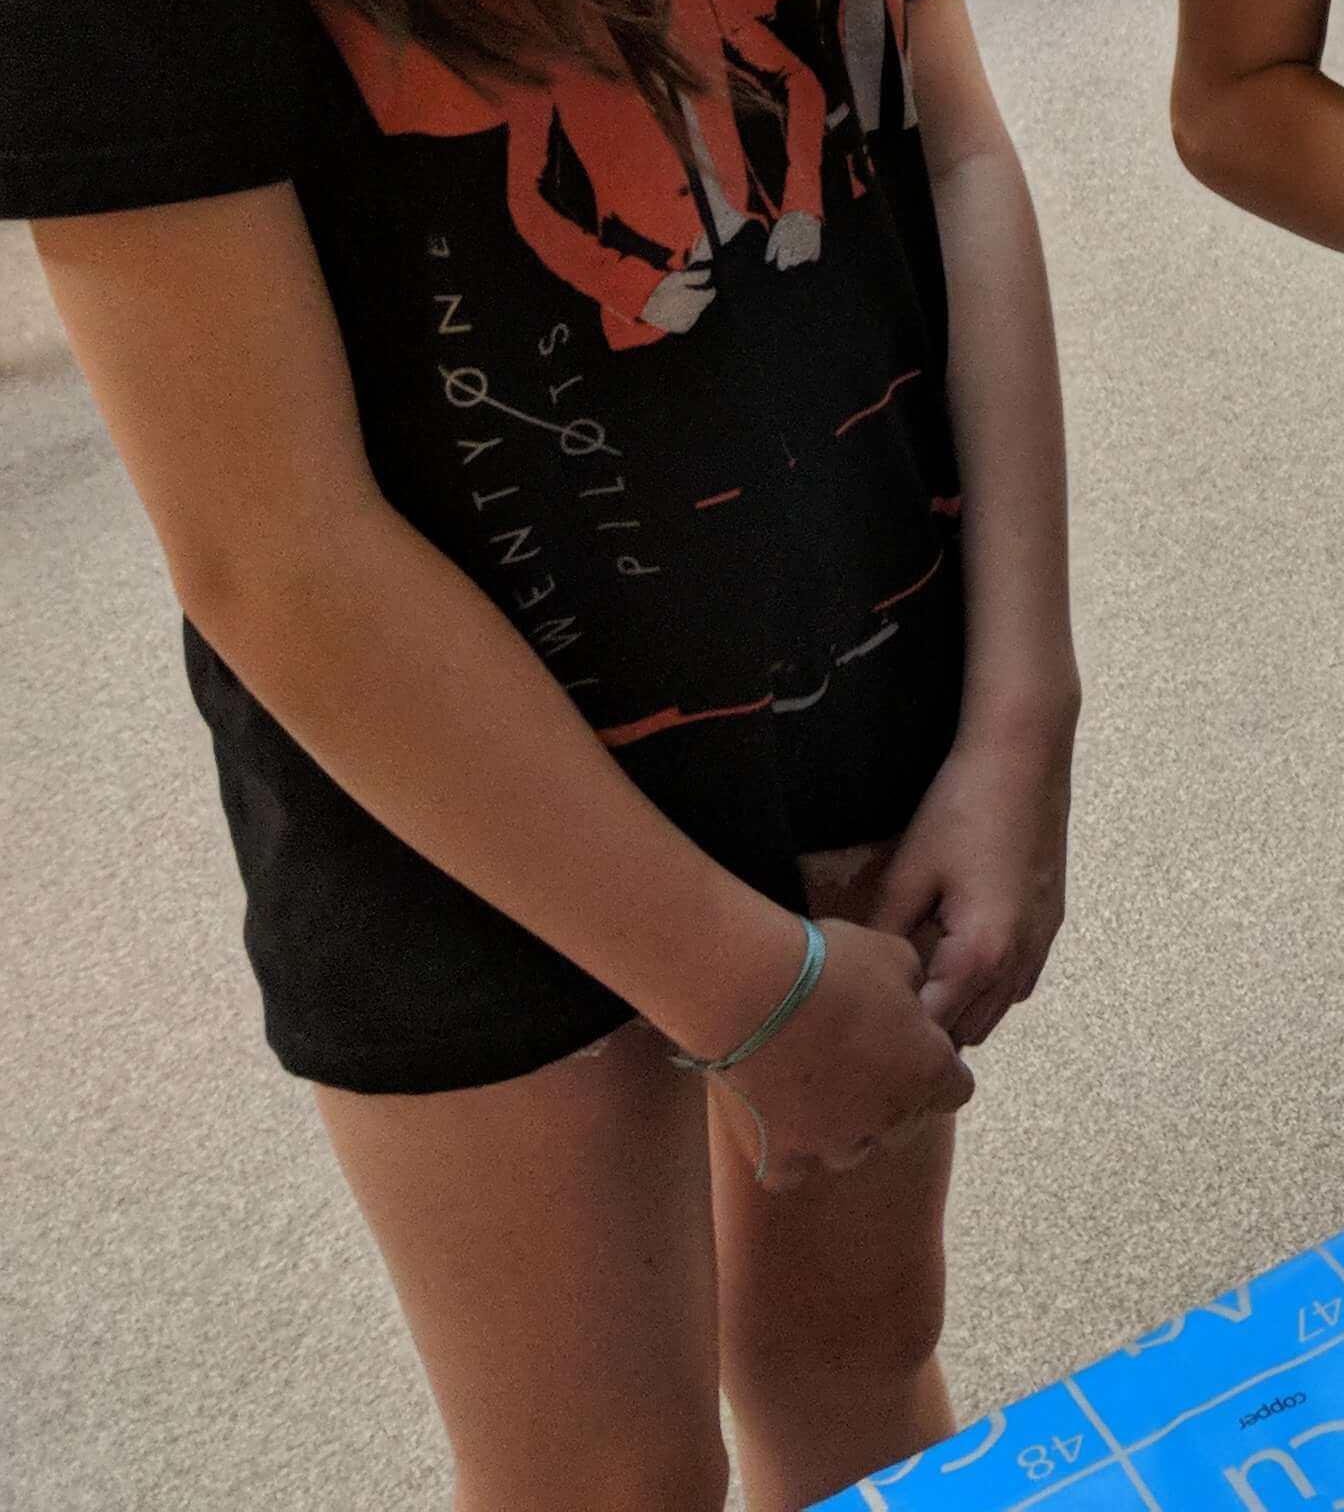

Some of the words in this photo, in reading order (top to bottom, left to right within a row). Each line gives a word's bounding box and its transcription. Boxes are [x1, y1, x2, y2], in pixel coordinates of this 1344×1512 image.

[1296, 1295, 1344, 1343] 47
[1239, 1391, 1308, 1431] copper
[1017, 1430, 1085, 1481] 48
